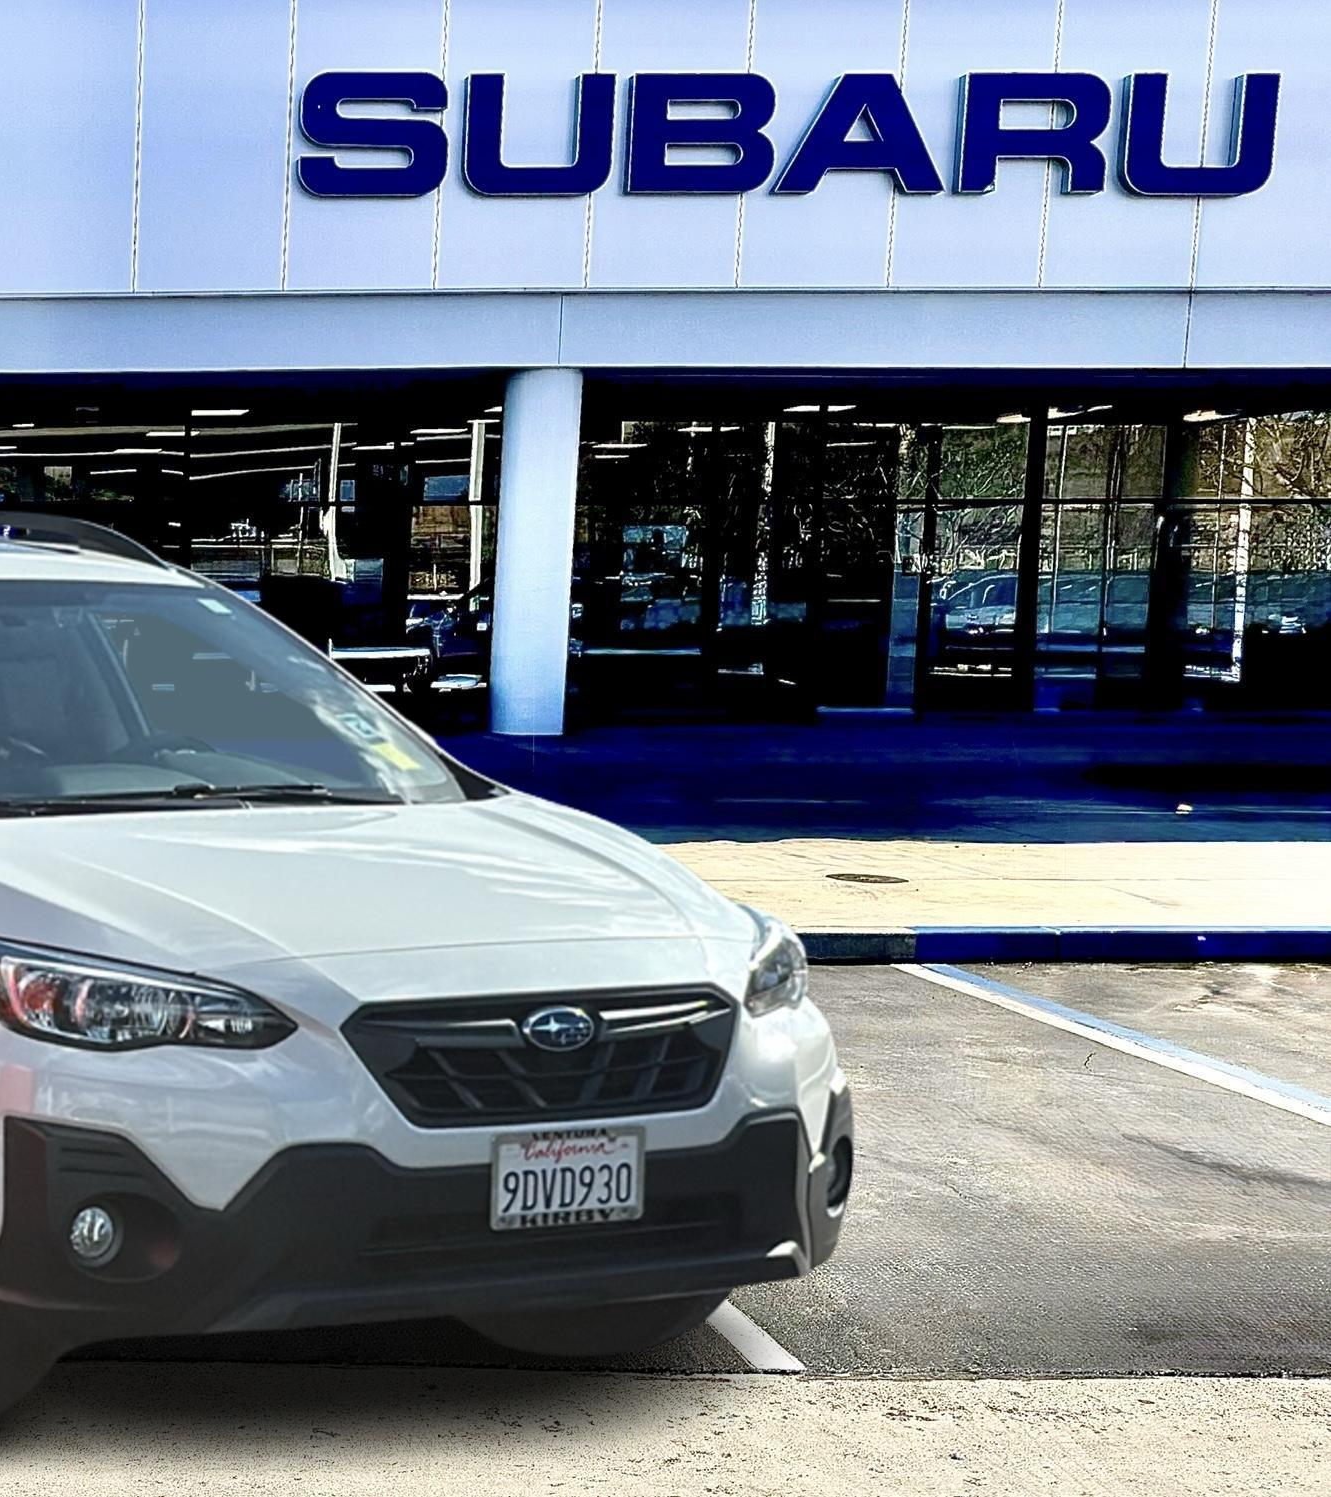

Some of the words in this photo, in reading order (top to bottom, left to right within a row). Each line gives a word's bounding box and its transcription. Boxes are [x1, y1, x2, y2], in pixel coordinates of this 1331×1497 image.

[296, 70, 1280, 197] SUBARU
[531, 1128, 608, 1141] VENTURA
[523, 1139, 614, 1164] California
[502, 1162, 632, 1214] 9DVD930
[520, 1209, 615, 1227] KIRBY
